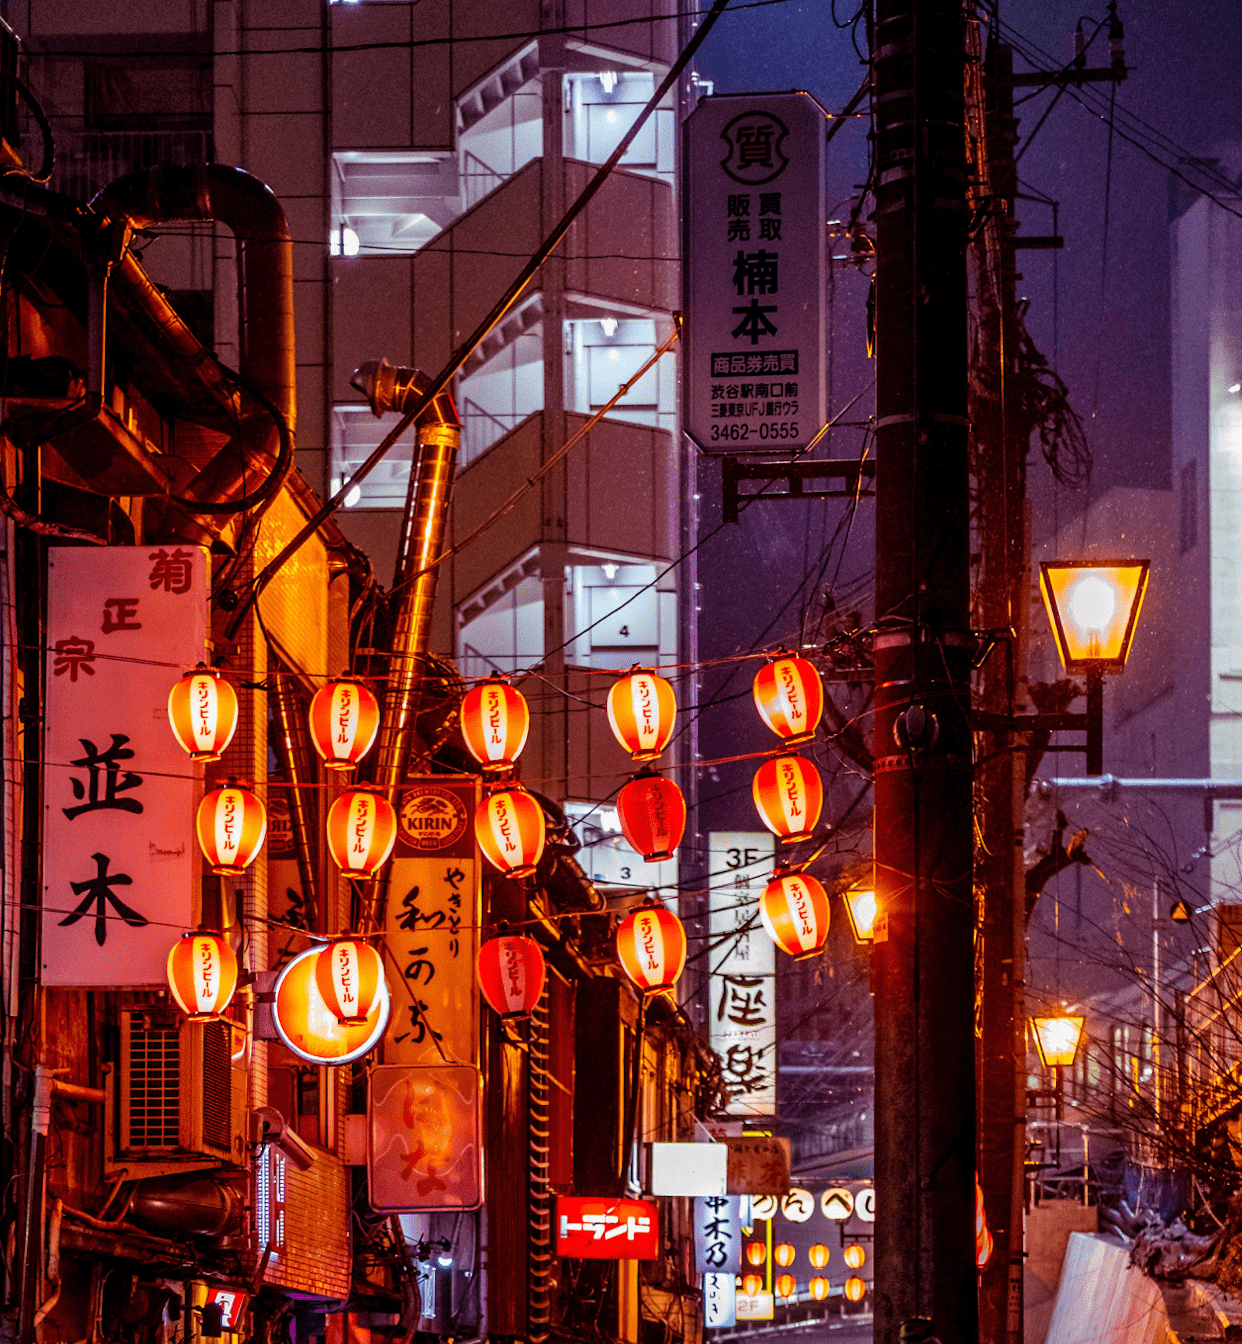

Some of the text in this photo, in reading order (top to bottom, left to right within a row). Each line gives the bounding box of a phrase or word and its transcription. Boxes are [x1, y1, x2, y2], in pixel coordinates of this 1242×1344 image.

[735, 125, 774, 170] 質
[727, 193, 751, 242] 販売
[758, 192, 782, 241] 買取
[731, 249, 779, 345] 楠本
[713, 353, 796, 374] 商品券売買
[711, 382, 799, 400] 渋谷駅南口前
[711, 422, 799, 441] 3462-0555
[619, 625, 630, 638] 4
[408, 817, 452, 831] KIRIN
[57, 733, 149, 948] 並木
[725, 848, 758, 869] 3F
[620, 867, 631, 880] 3
